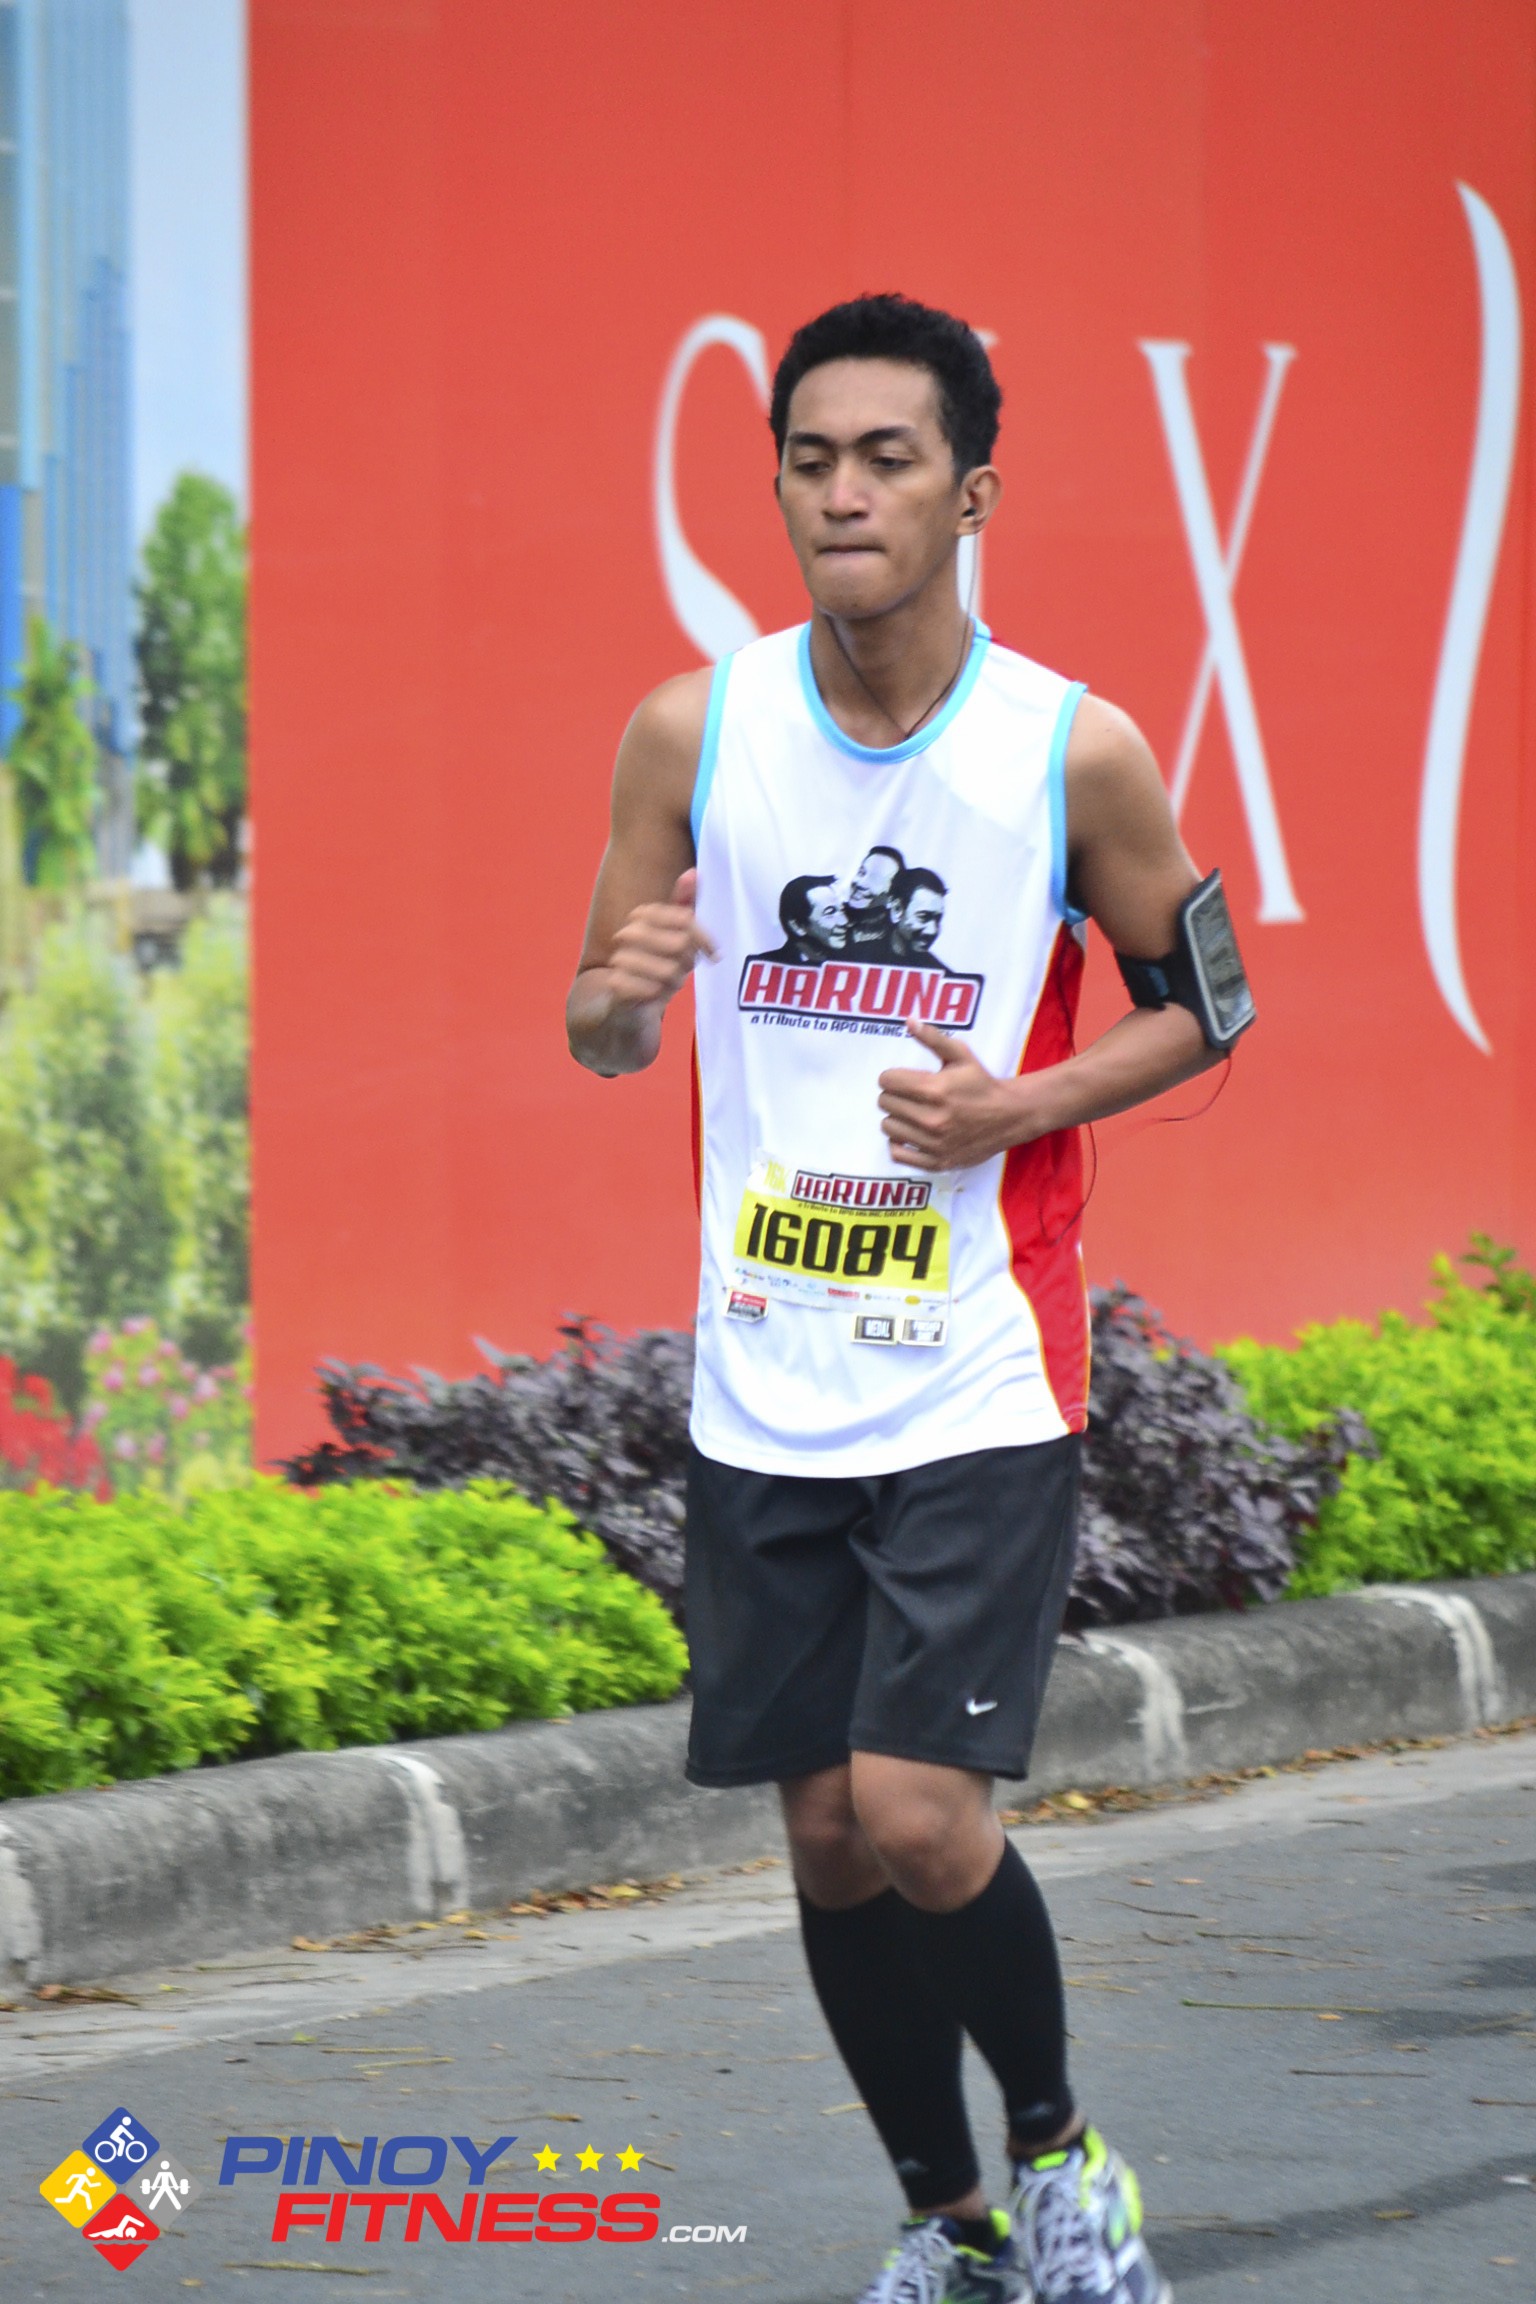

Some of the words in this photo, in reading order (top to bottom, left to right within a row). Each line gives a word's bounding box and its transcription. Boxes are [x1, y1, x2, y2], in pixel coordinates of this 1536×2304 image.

[743, 963, 975, 1023] HARUNA
[751, 1014, 760, 1024] a
[762, 1012, 811, 1030] tribute
[813, 1018, 828, 1031] to
[830, 1020, 858, 1034] APO
[859, 1022, 902, 1037] HIKING
[794, 1175, 928, 1207] HARUNA
[746, 1202, 938, 1281] 16084
[864, 1319, 891, 1338] MEDAL
